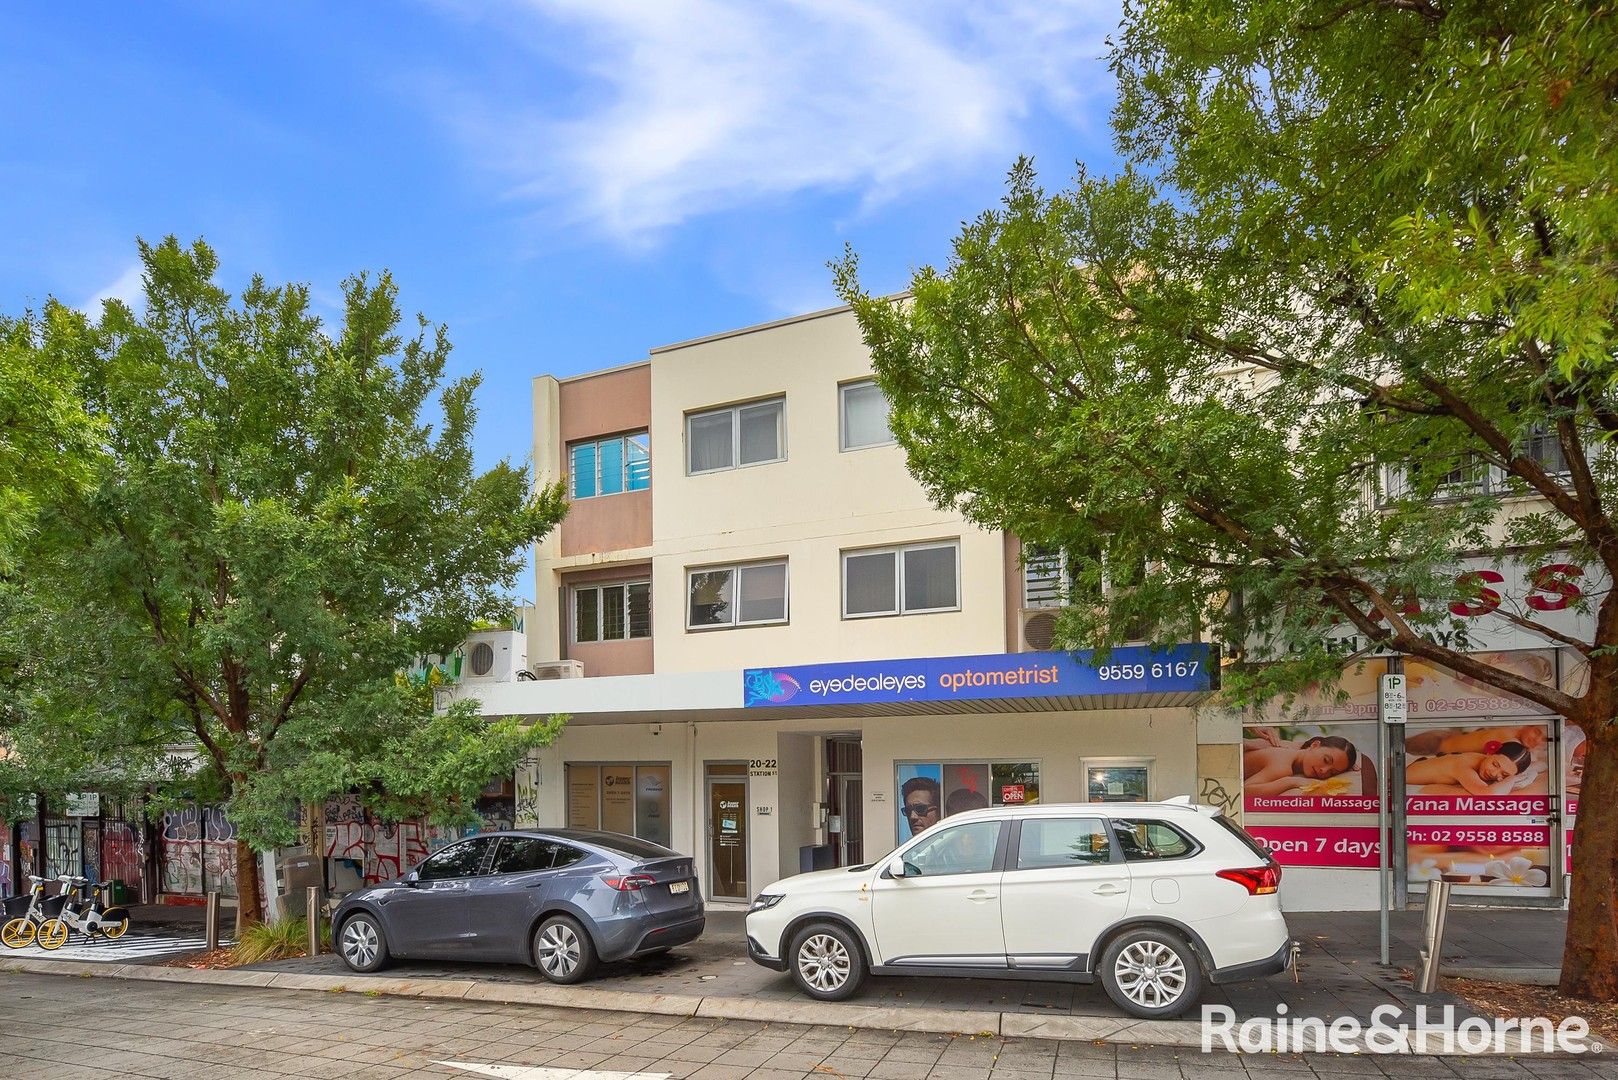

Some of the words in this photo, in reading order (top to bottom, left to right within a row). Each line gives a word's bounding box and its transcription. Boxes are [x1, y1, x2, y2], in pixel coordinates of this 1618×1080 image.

[810, 673, 926, 697] eyedealeyes
[939, 664, 1059, 692] optometrist
[1099, 664, 1145, 681] 9559
[1151, 661, 1199, 678] 6167
[1388, 677, 1401, 690] 1P
[750, 759, 777, 768] 20-22
[1253, 797, 1314, 808] Remedial
[1321, 797, 1380, 810] Massage
[1455, 797, 1545, 815] Massage
[1431, 831, 1451, 842] 02
[1455, 831, 1497, 843] 9558
[1501, 831, 1545, 843] 8588
[1315, 838, 1328, 853] 7
